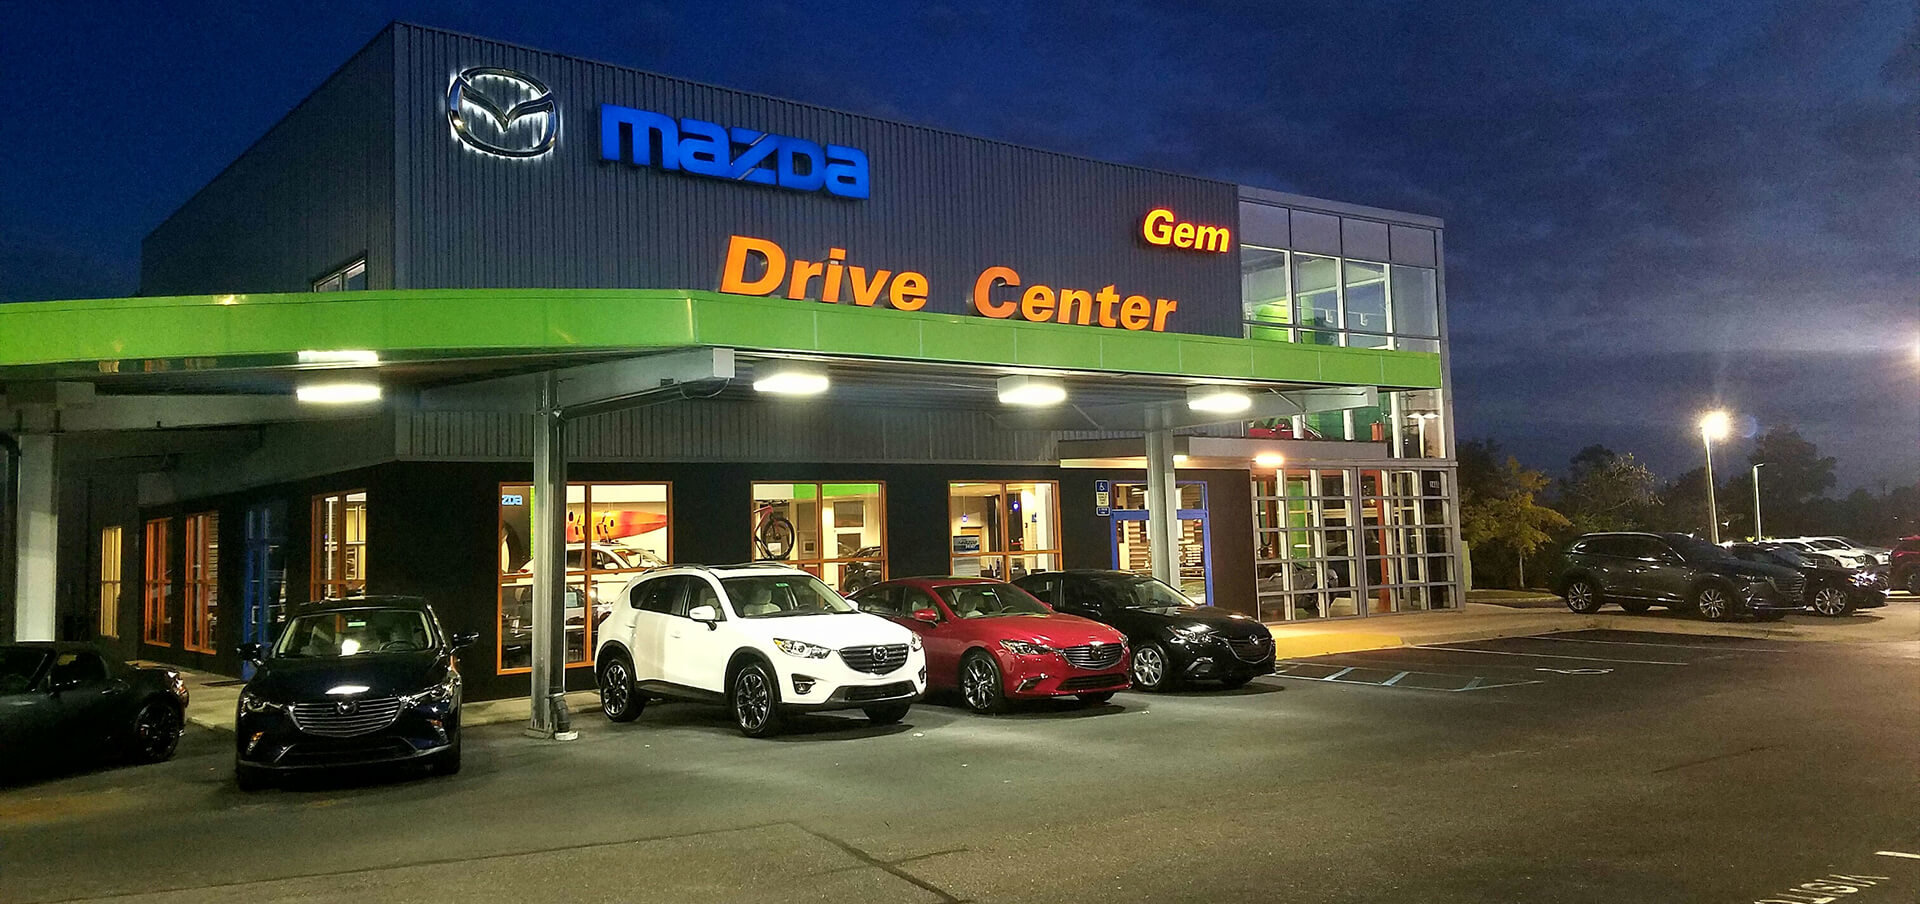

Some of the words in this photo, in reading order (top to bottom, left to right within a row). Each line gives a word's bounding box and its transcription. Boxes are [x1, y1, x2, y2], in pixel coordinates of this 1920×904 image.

[1143, 208, 1231, 253] Gem
[720, 235, 930, 311] Drive
[973, 266, 1178, 332] Center
